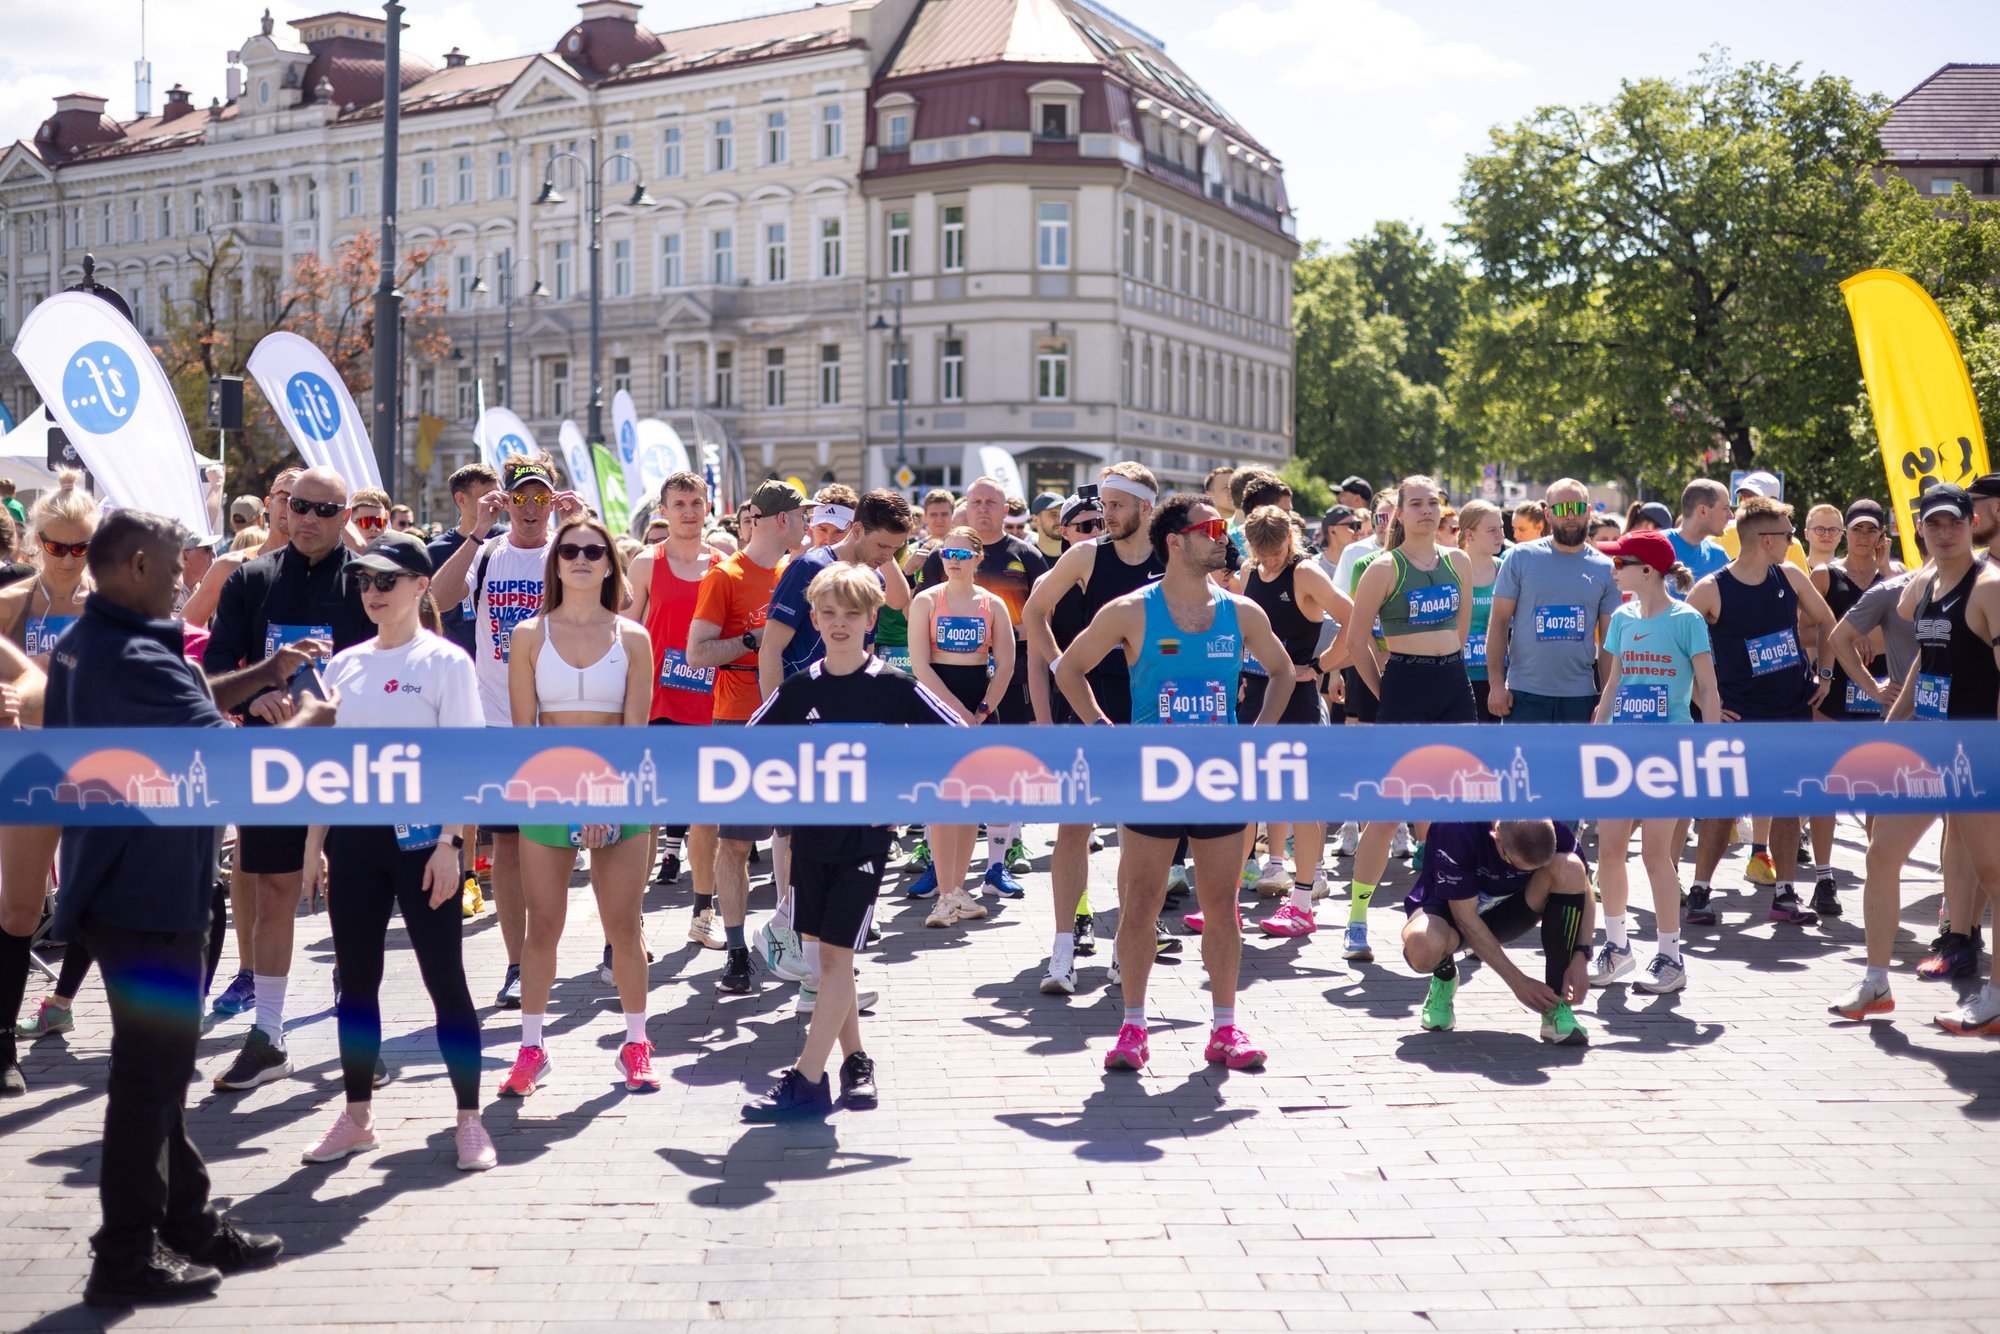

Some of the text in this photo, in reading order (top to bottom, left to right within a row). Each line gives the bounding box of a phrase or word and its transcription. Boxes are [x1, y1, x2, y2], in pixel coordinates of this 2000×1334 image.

[514, 466, 547, 480] SRIXON
[1420, 597, 1451, 614] 40444
[1545, 616, 1576, 629] 40725
[946, 628, 977, 641] 40020
[1206, 640, 1235, 652] NEKO
[1760, 643, 1789, 662] 40162
[673, 663, 706, 681] 40629
[1621, 667, 1677, 677] unners
[401, 683, 422, 694] dpd
[1173, 695, 1214, 713] 40115
[1623, 698, 1655, 713] 40060
[251, 743, 422, 804] Delfi
[697, 742, 867, 803] Delfi
[1141, 741, 1309, 801] Delfi
[1580, 739, 1749, 799] Delfi
